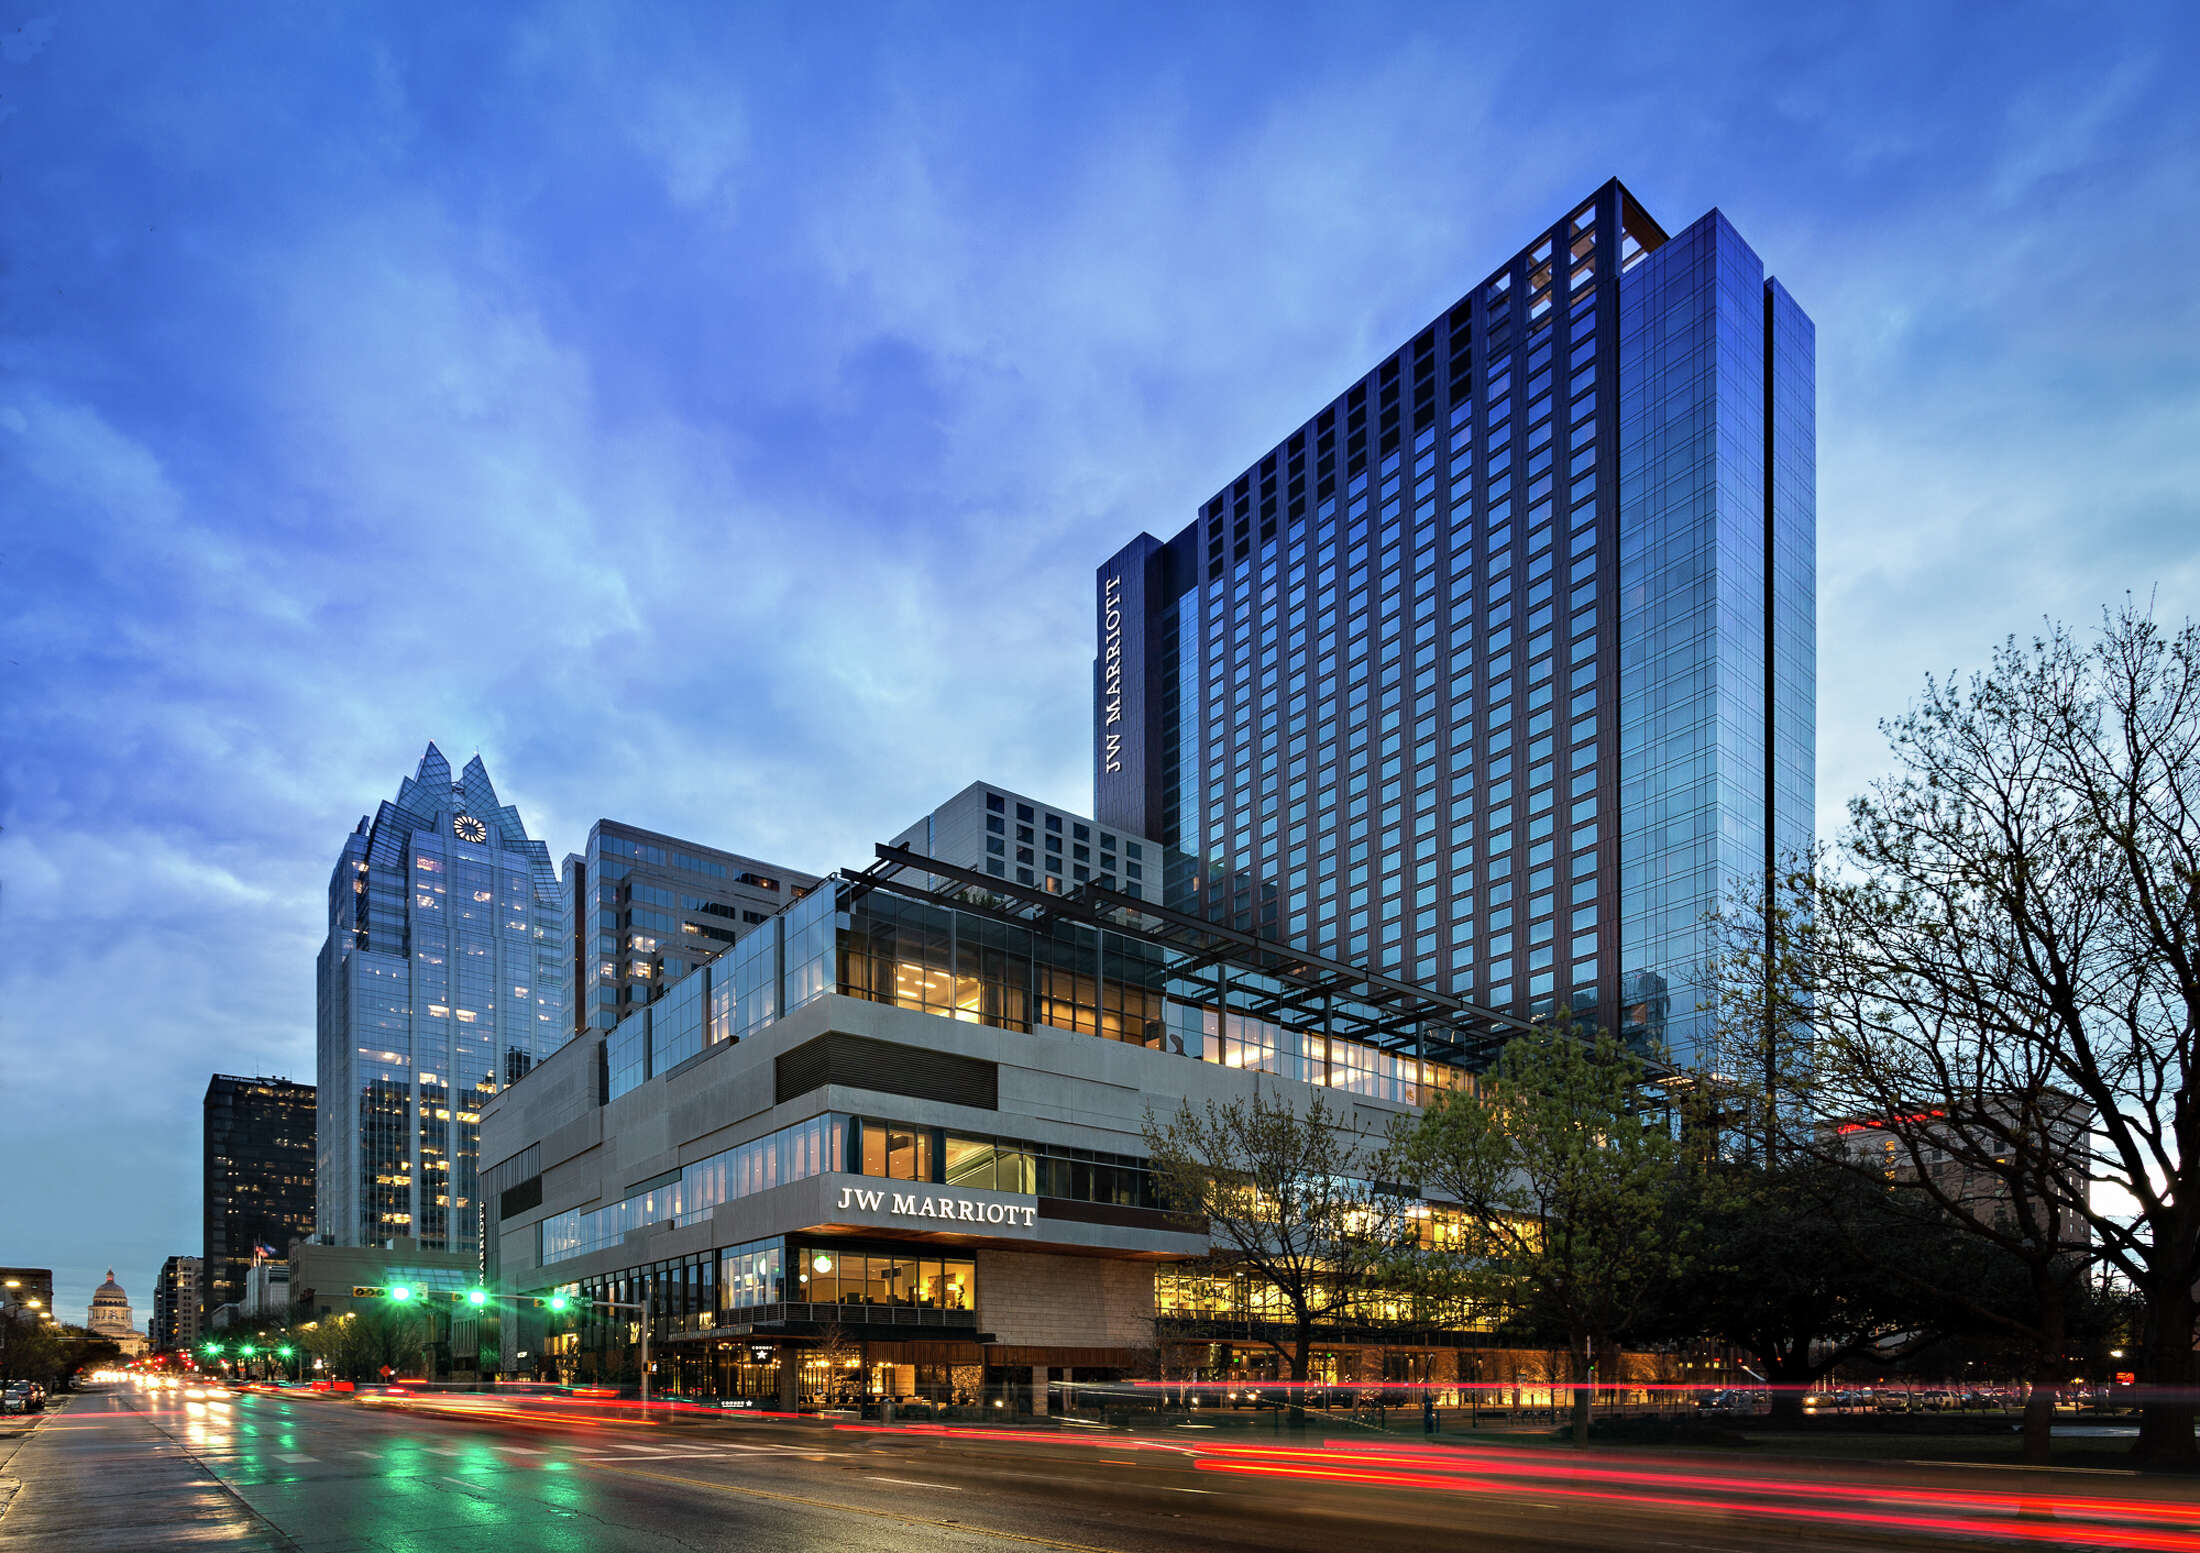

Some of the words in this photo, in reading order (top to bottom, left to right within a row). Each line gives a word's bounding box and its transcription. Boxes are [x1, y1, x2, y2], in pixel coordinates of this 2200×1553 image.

[1106, 575, 1121, 726] MARRIOTT
[1106, 734, 1121, 774] JW
[837, 1187, 885, 1212] JW
[891, 1193, 1036, 1227] MARRIOTT
